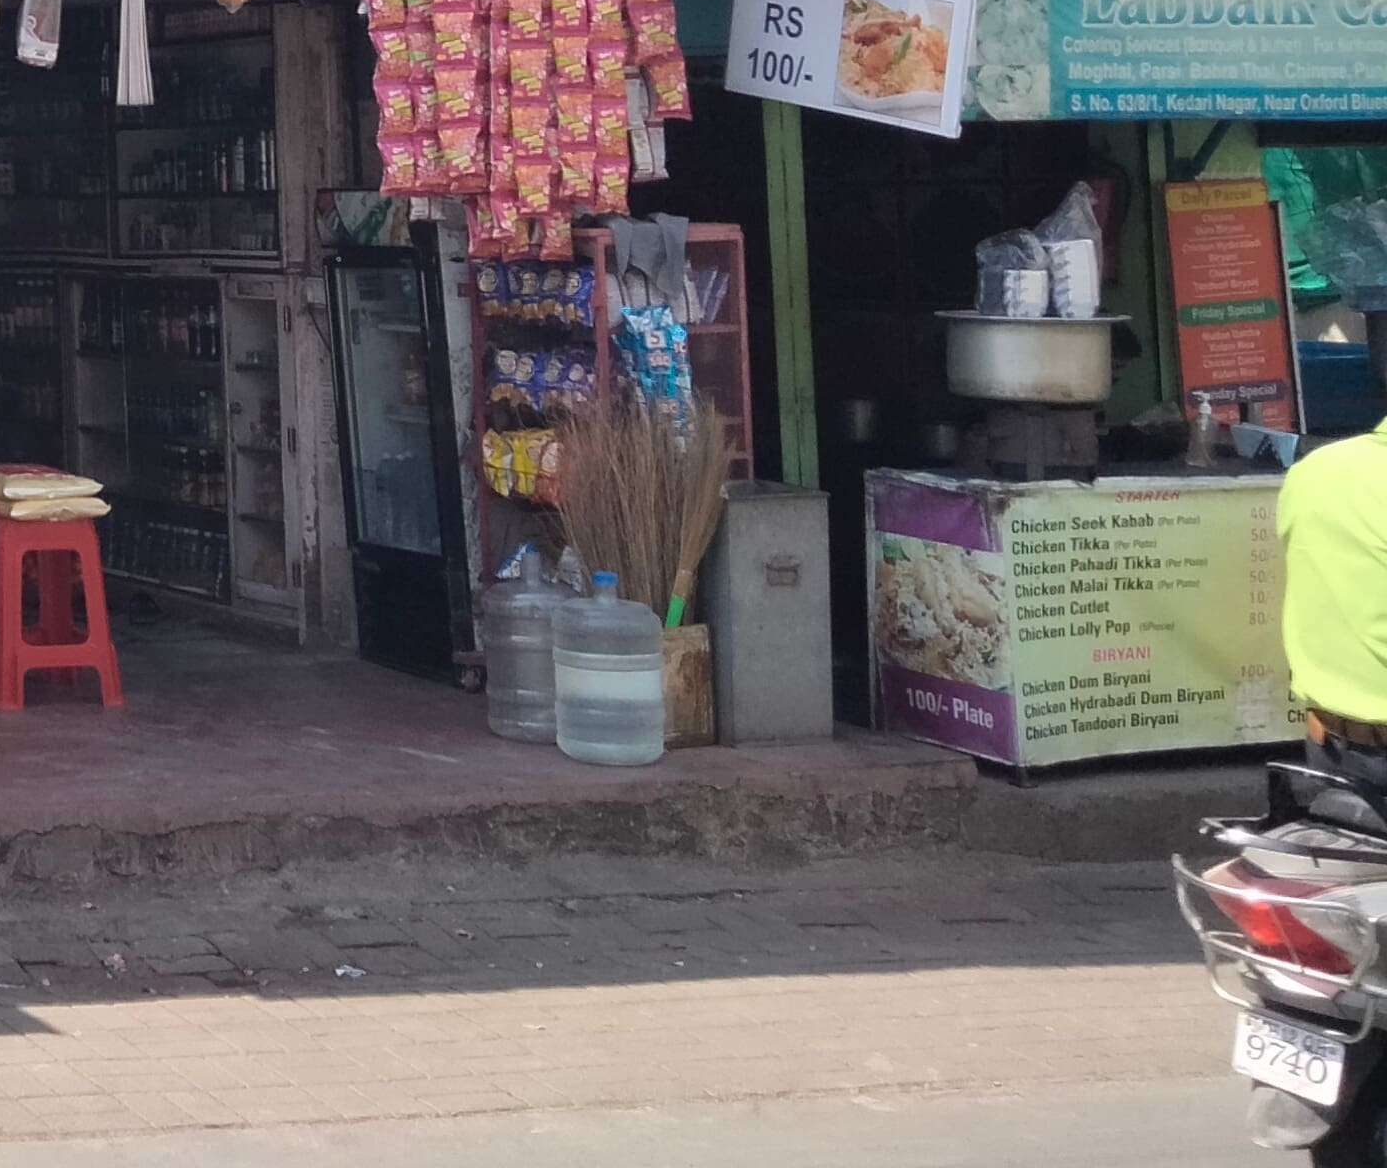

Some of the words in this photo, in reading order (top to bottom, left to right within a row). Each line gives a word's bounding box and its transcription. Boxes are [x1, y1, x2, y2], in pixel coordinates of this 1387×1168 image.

[764, 2, 804, 39] RS
[747, 47, 814, 88] 100/-
[1071, 95, 1086, 112] S.
[1089, 94, 1114, 112] No.
[1166, 94, 1213, 112] Kedari
[1264, 94, 1297, 111] Near
[1300, 93, 1348, 111] Oxford
[1227, 302, 1266, 318] Special
[1238, 383, 1277, 400] Special
[1114, 490, 1180, 503] STARTER
[1011, 518, 1066, 534] Chicken
[1071, 516, 1108, 531] Seek
[1111, 513, 1154, 529] Kabab
[1011, 540, 1066, 555] Chicken
[1070, 536, 1110, 551] Tikka
[1013, 561, 1066, 577] Chicken
[1070, 557, 1119, 572] Pahadi
[1122, 554, 1161, 570] Tikka
[1015, 582, 1065, 599] Chicken
[1070, 578, 1108, 594] Malai
[1113, 577, 1154, 591] Tikka
[1016, 604, 1065, 620] Chicken
[1070, 600, 1110, 616] Cutlet
[1018, 626, 1065, 643] Chicken
[1070, 621, 1101, 638] Lolly
[1105, 619, 1131, 636] Pop
[1092, 646, 1152, 663] BIRYANI
[1022, 680, 1065, 698] Chicken
[1069, 675, 1099, 690] Dum
[1103, 669, 1152, 687] Biryani
[906, 687, 950, 716] 100/-
[952, 696, 995, 729] Plate
[1024, 702, 1066, 720] Chicken
[1070, 693, 1137, 713] Hydrabadi
[1140, 690, 1173, 705] Dum
[1176, 686, 1226, 705] Biryani
[1025, 724, 1067, 742] Chicken
[1071, 714, 1127, 733] Tandoori
[1130, 712, 1180, 729] Biryani
[1287, 709, 1306, 723] Ch
[1245, 1033, 1328, 1084] 9740
